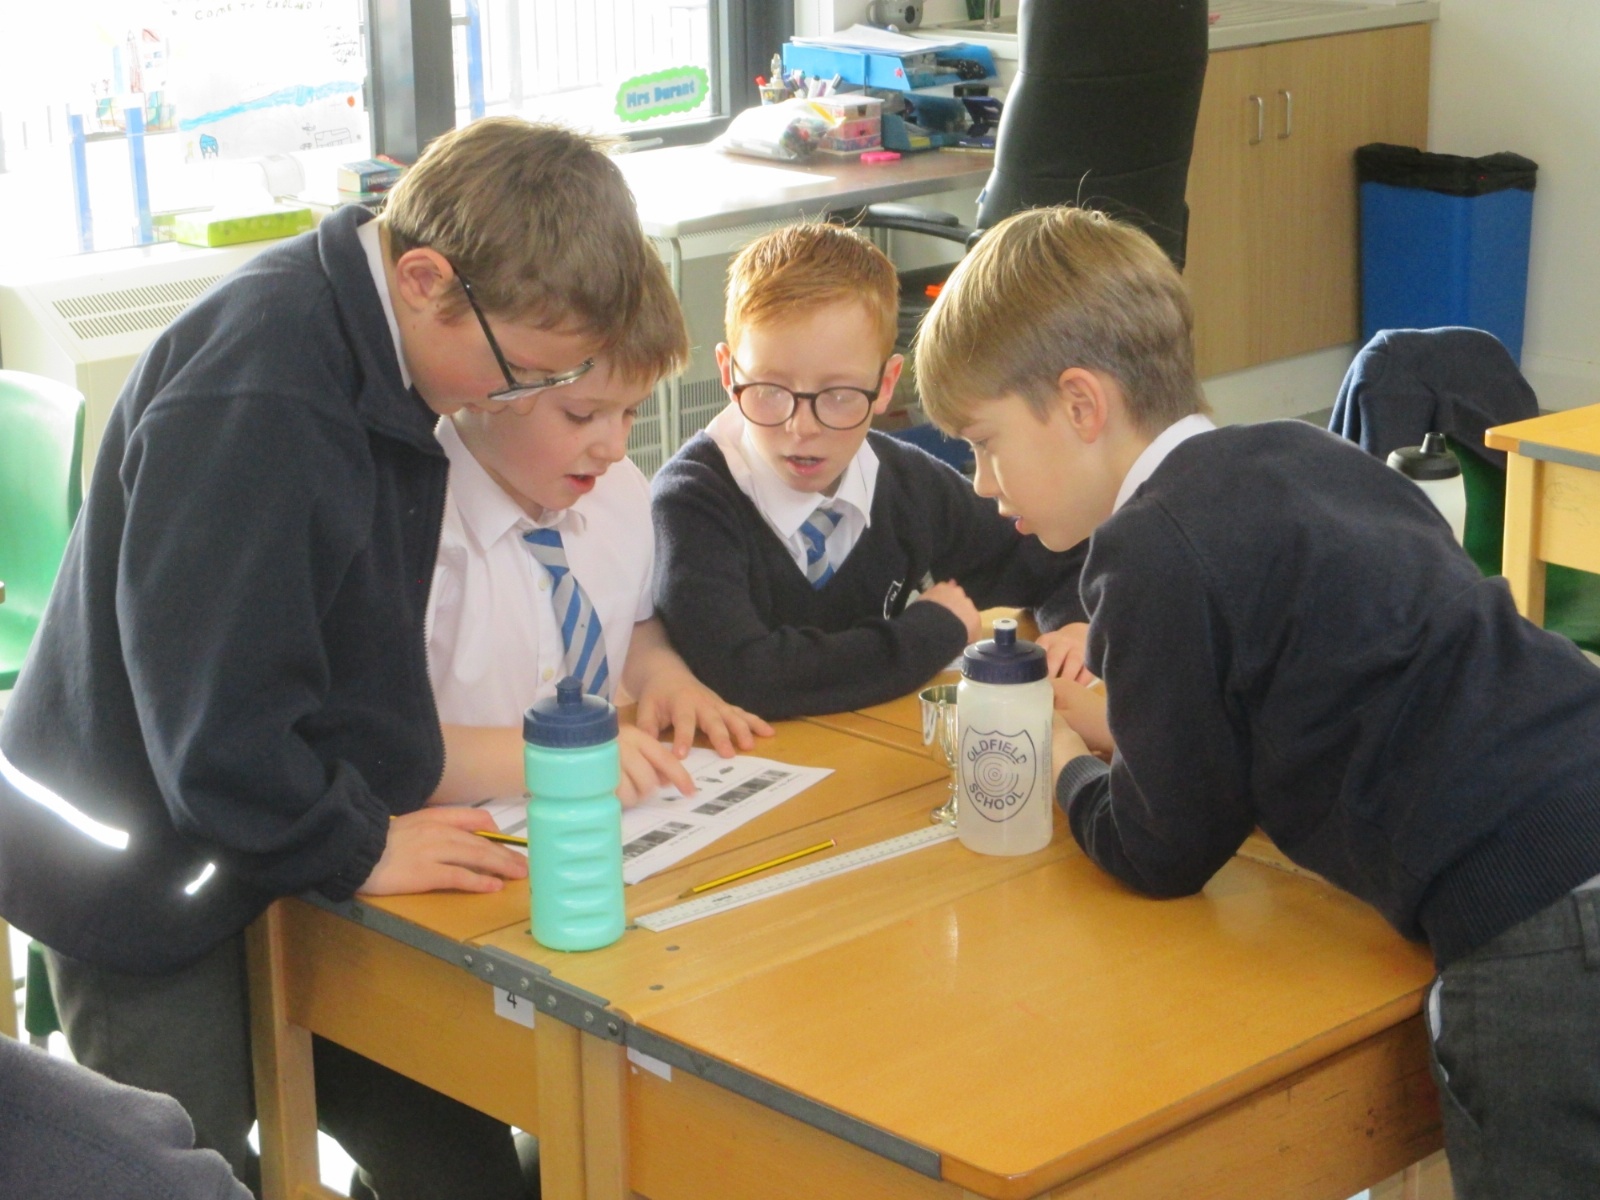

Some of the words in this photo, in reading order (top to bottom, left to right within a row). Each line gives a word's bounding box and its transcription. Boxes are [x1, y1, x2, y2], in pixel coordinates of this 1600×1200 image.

[966, 739, 1028, 765] OLDFIELD
[969, 782, 1025, 811] SCHOOL
[506, 991, 518, 1010] 4
